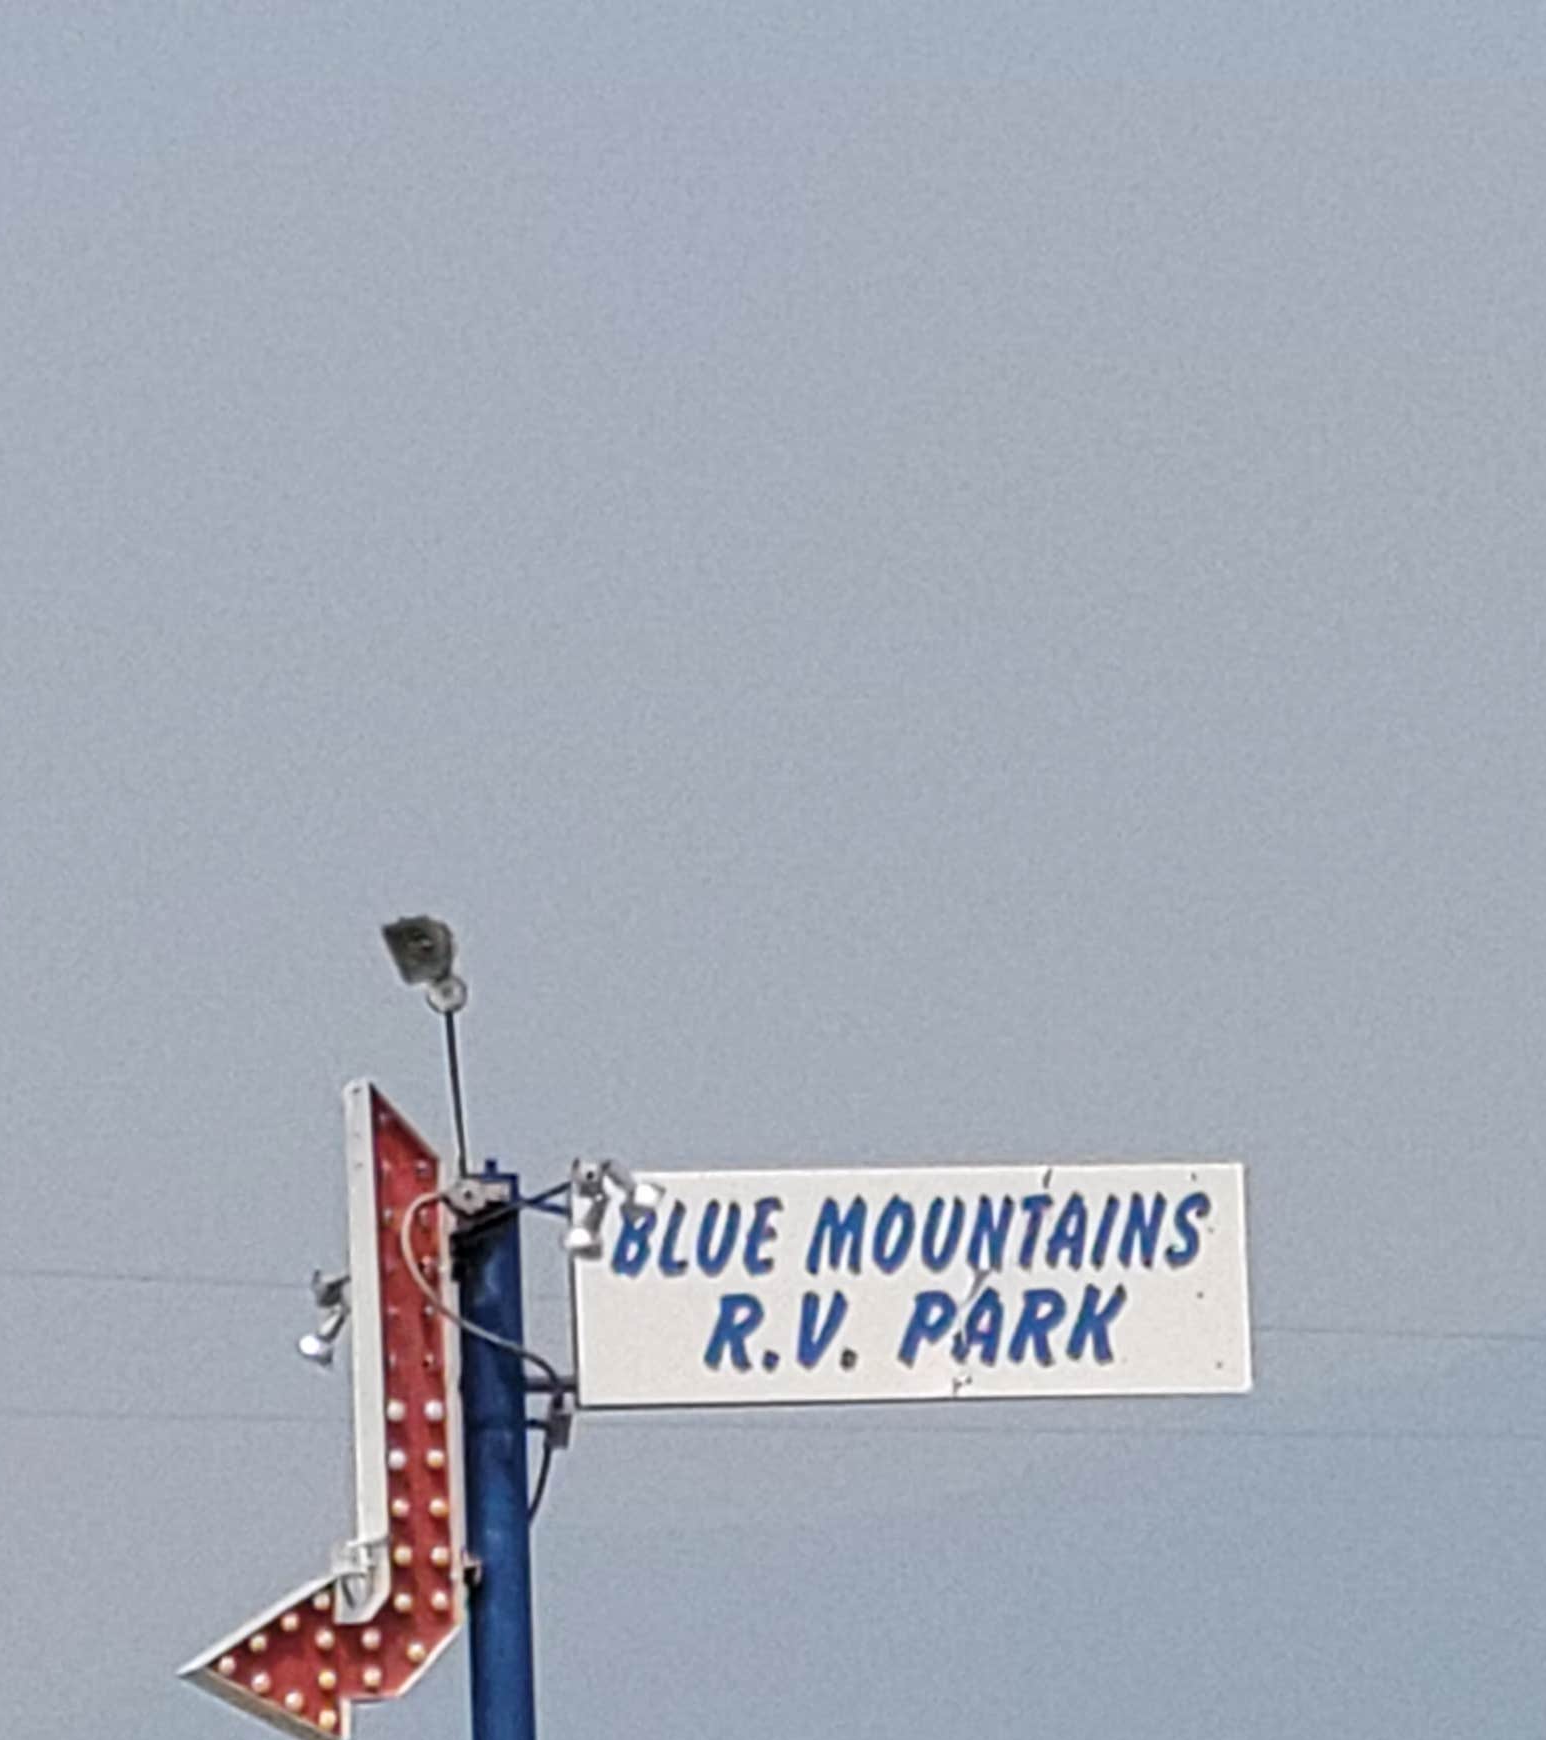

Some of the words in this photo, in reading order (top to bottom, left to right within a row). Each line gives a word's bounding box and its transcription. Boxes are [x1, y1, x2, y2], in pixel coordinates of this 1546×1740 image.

[610, 1195, 784, 1278] BLUE
[805, 1190, 1211, 1275] MOUNTAINS
[703, 1293, 858, 1372] R.V.
[896, 1283, 1127, 1368] PARK
